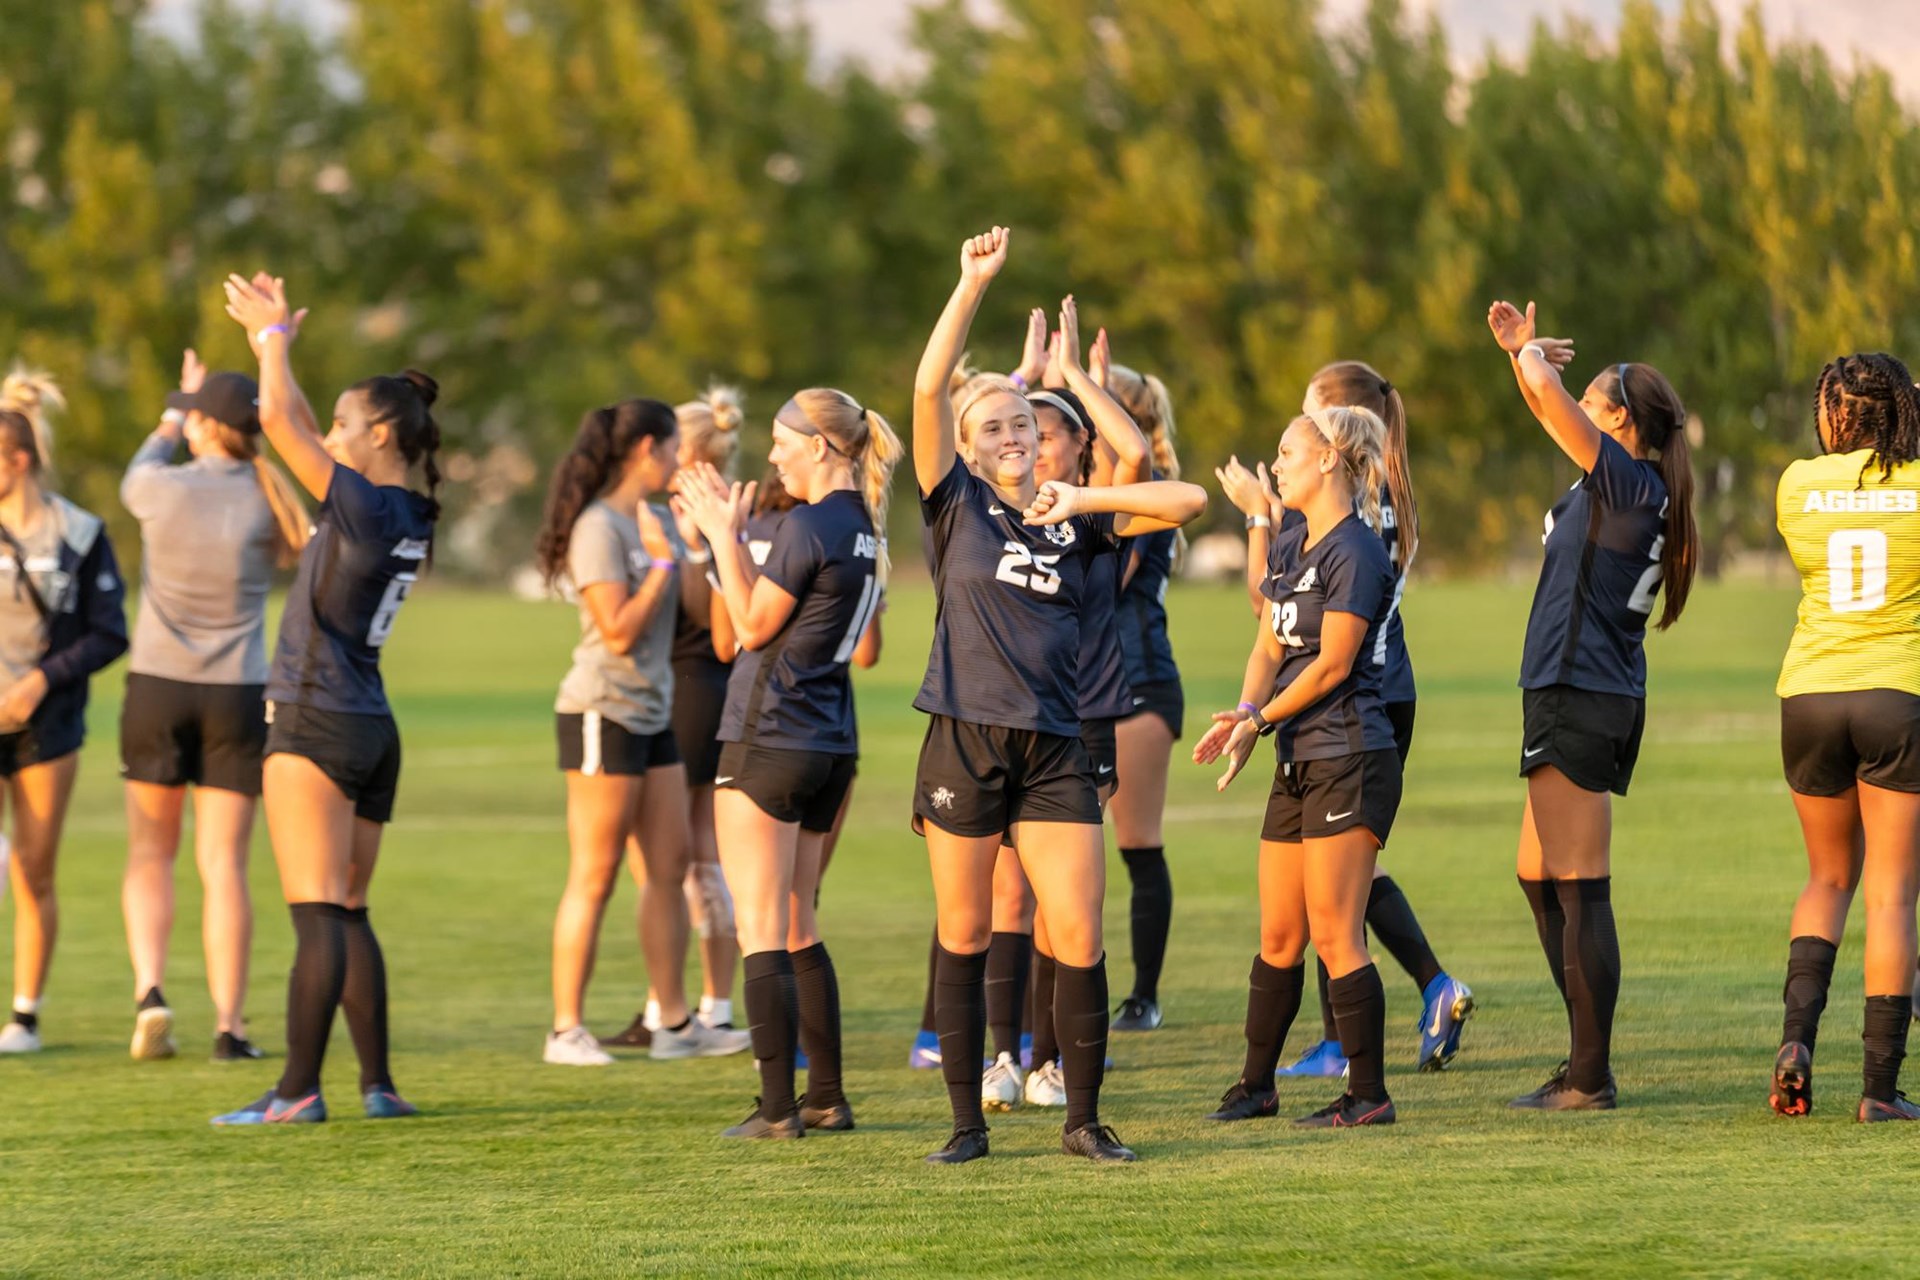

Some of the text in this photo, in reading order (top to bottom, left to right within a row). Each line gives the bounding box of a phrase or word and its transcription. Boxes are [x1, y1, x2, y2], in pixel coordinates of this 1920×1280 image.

[1802, 489, 1917, 513] AGGIES
[995, 540, 1062, 595] 25
[1828, 529, 1887, 613] 0
[1272, 601, 1305, 648] 22
